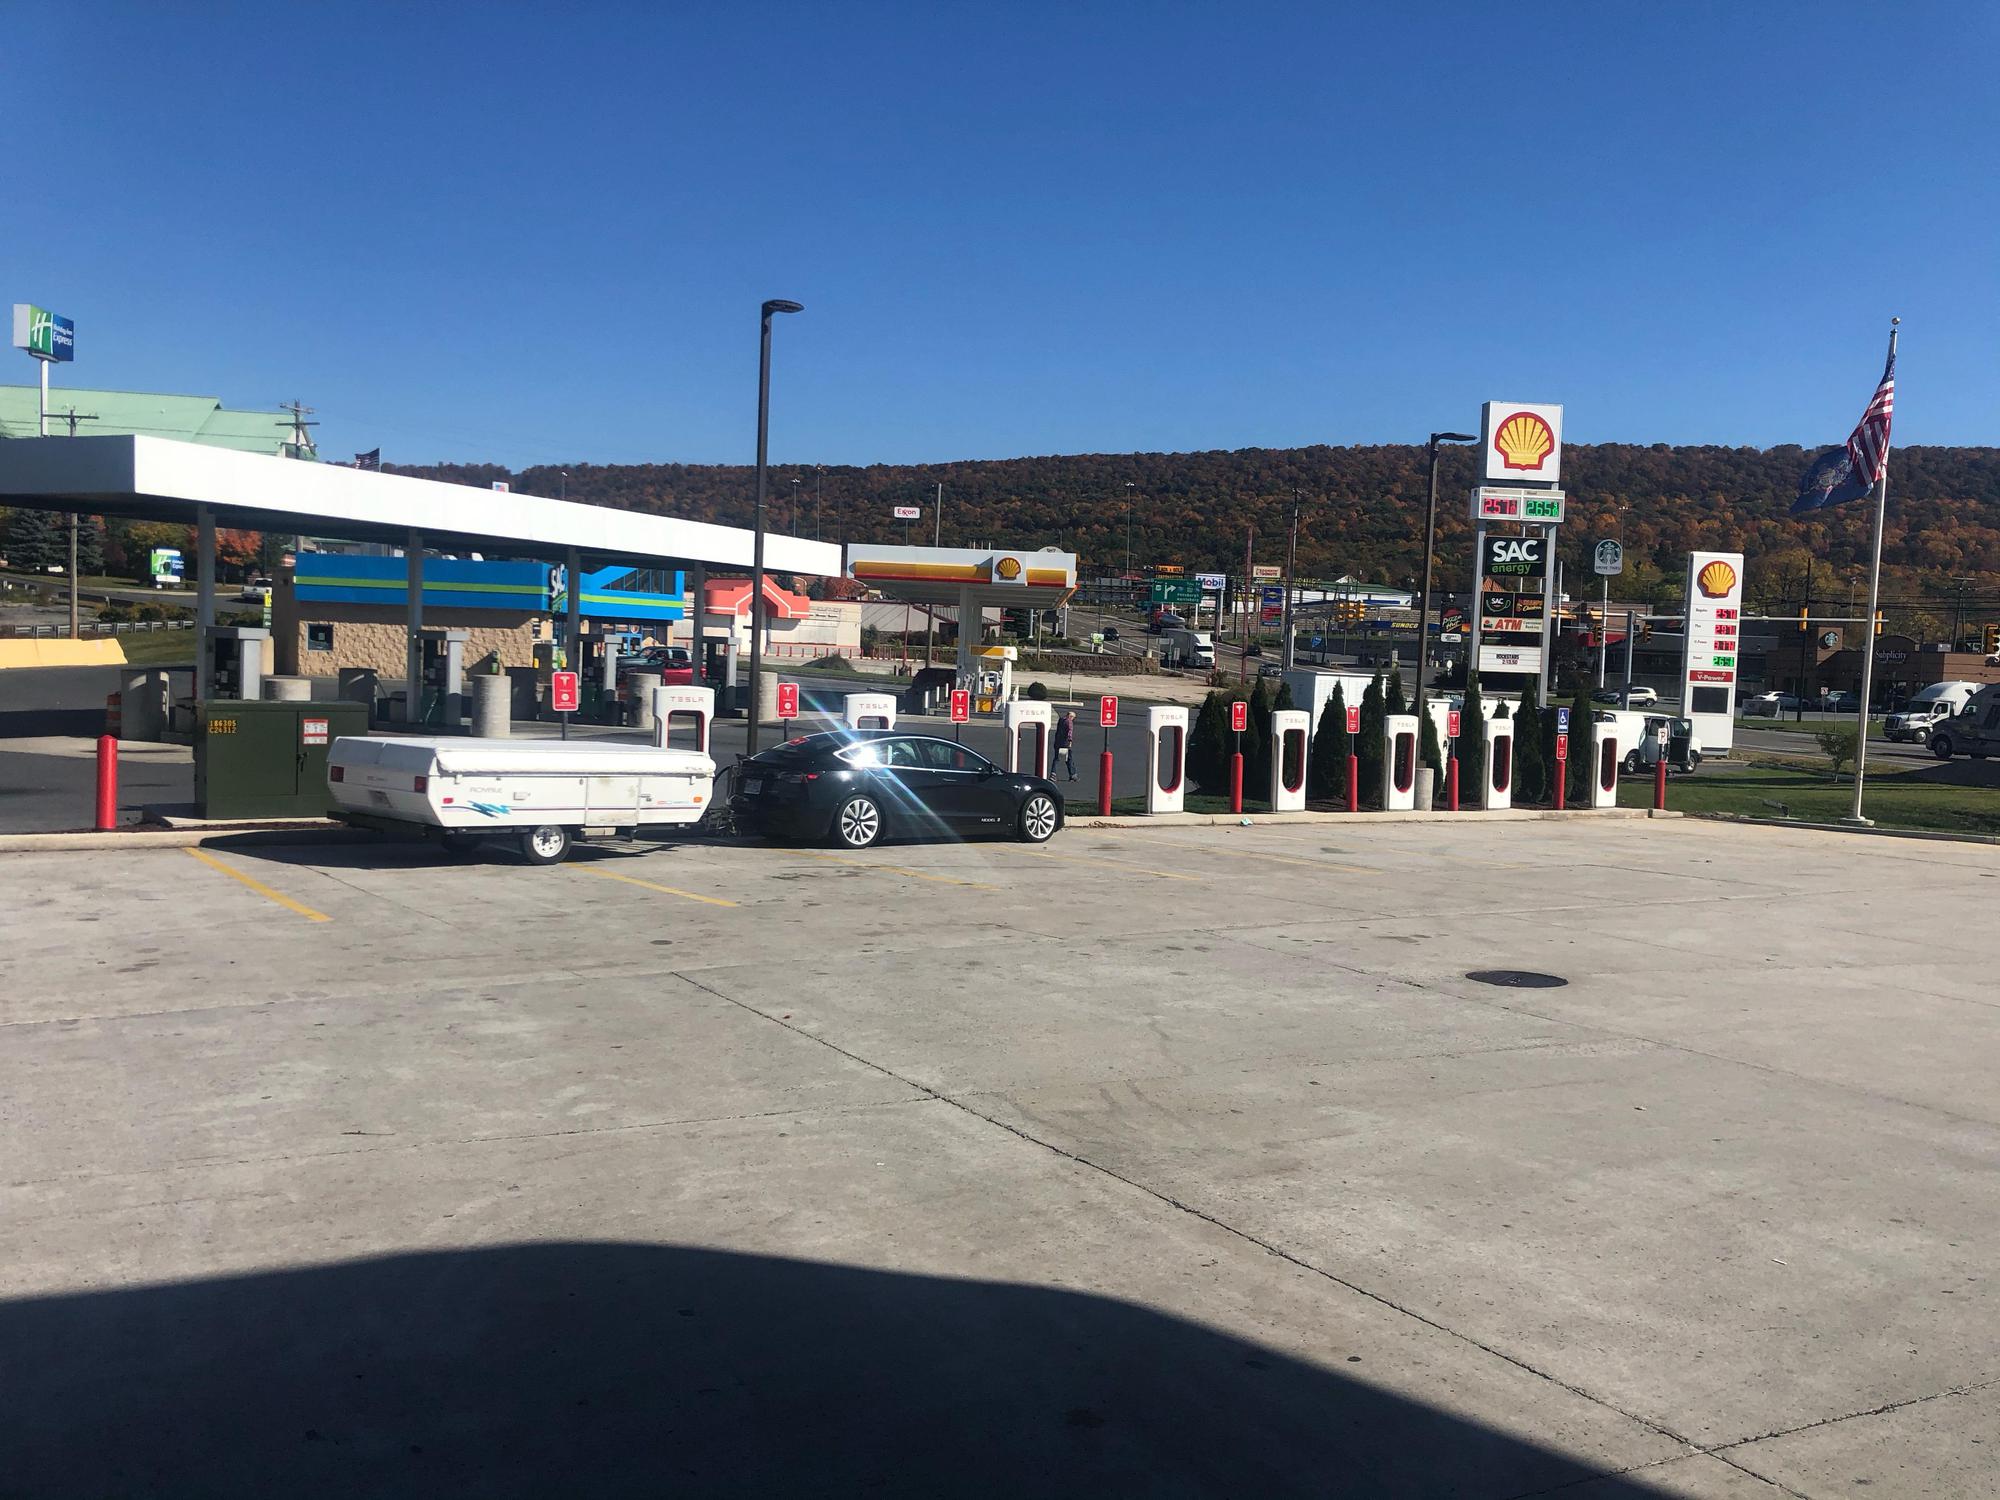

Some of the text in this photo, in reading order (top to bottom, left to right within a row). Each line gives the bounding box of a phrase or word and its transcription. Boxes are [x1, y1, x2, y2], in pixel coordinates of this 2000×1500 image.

[53, 332, 73, 346] Express
[897, 508, 917, 516] Exxon
[1492, 540, 1539, 562] SAC
[1491, 564, 1531, 574] energy
[1198, 577, 1224, 587] Mobil
[1442, 615, 1462, 627] Pizza
[1446, 621, 1460, 630] Hut
[1494, 619, 1522, 630] ATM
